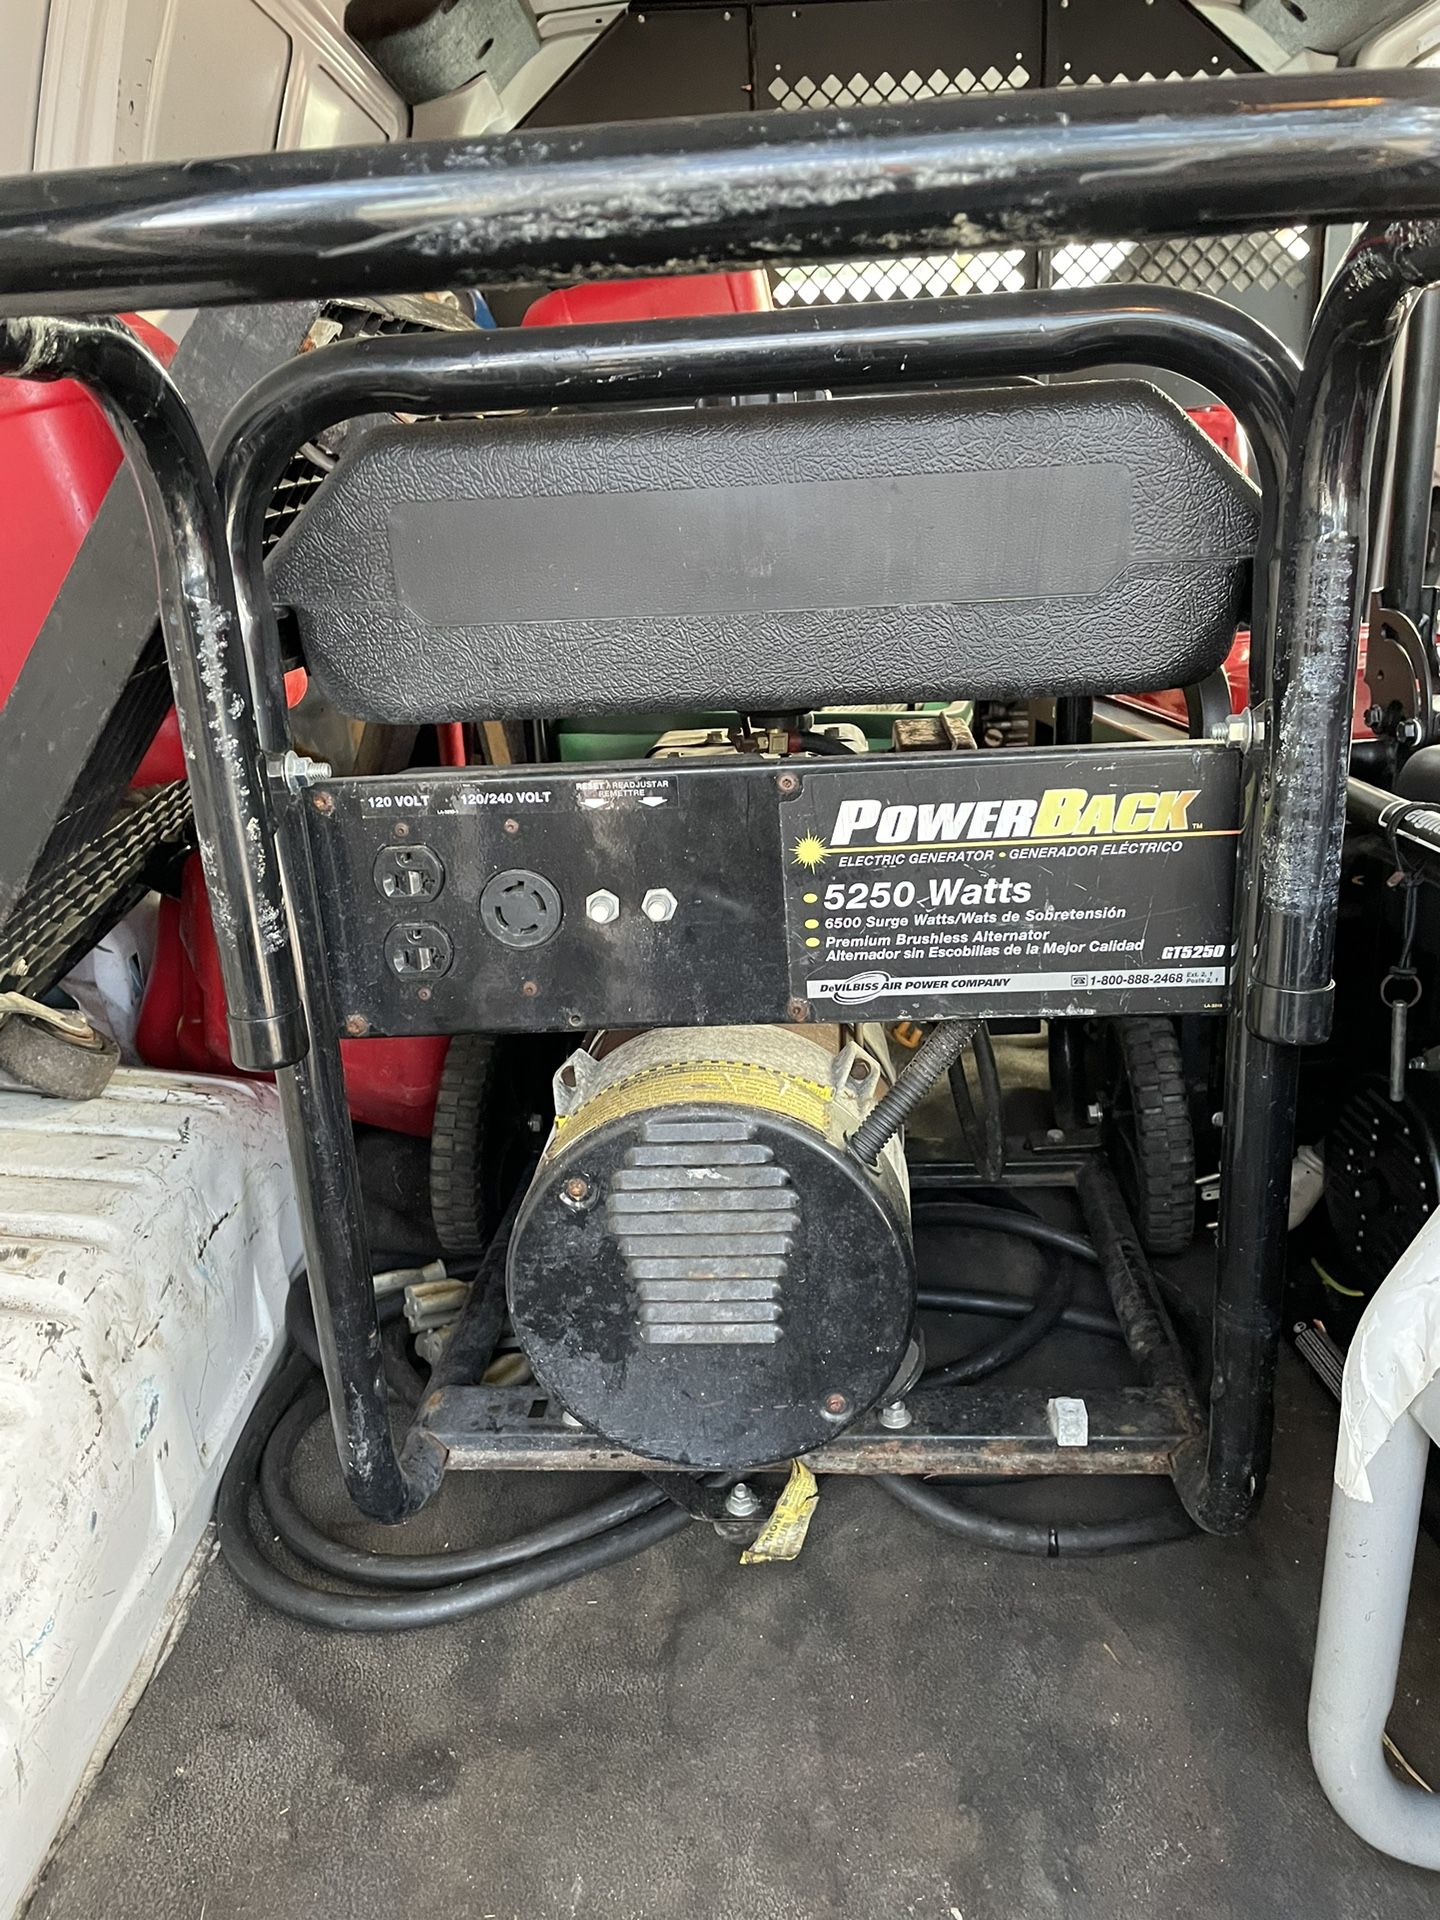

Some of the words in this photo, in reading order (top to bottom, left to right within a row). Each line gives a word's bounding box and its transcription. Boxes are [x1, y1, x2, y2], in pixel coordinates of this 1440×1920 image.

[612, 780, 669, 789] READJUSTAR
[461, 793, 514, 805] 120/240
[516, 792, 551, 803] VOLT
[598, 788, 645, 797] REMETTRE
[368, 796, 392, 808] 120
[394, 795, 430, 807] VOLT
[838, 853, 905, 867] ELECTRIC
[908, 850, 995, 865] GENERATOR
[1009, 845, 1098, 860] GENERADOR
[1101, 841, 1183, 856] ELÉCTRICO
[823, 881, 916, 910] 5250
[928, 877, 1032, 907] Watts
[824, 917, 862, 929] 6500
[866, 916, 909, 929] Surge
[914, 911, 998, 926] Watts/Wats
[1001, 911, 1020, 923] de
[1025, 906, 1127, 922] Sobretensión
[825, 935, 891, 948] Premium
[895, 931, 969, 946] Brushless
[972, 930, 1050, 942] Alternator
[825, 949, 904, 962] Alternador
[903, 947, 925, 959] sin
[928, 943, 1000, 958] Escobillas
[1003, 943, 1022, 956] de
[1025, 943, 1040, 955] la
[1043, 941, 1086, 956] Mejor
[1088, 938, 1146, 953] Calidad
[1161, 944, 1226, 959] GT5250
[819, 981, 879, 992] DeVILBISS
[881, 981, 902, 991] AIR
[904, 980, 949, 990] POWER
[951, 978, 1011, 988] COMPANY
[1090, 973, 1183, 986] 1-800-888-2468
